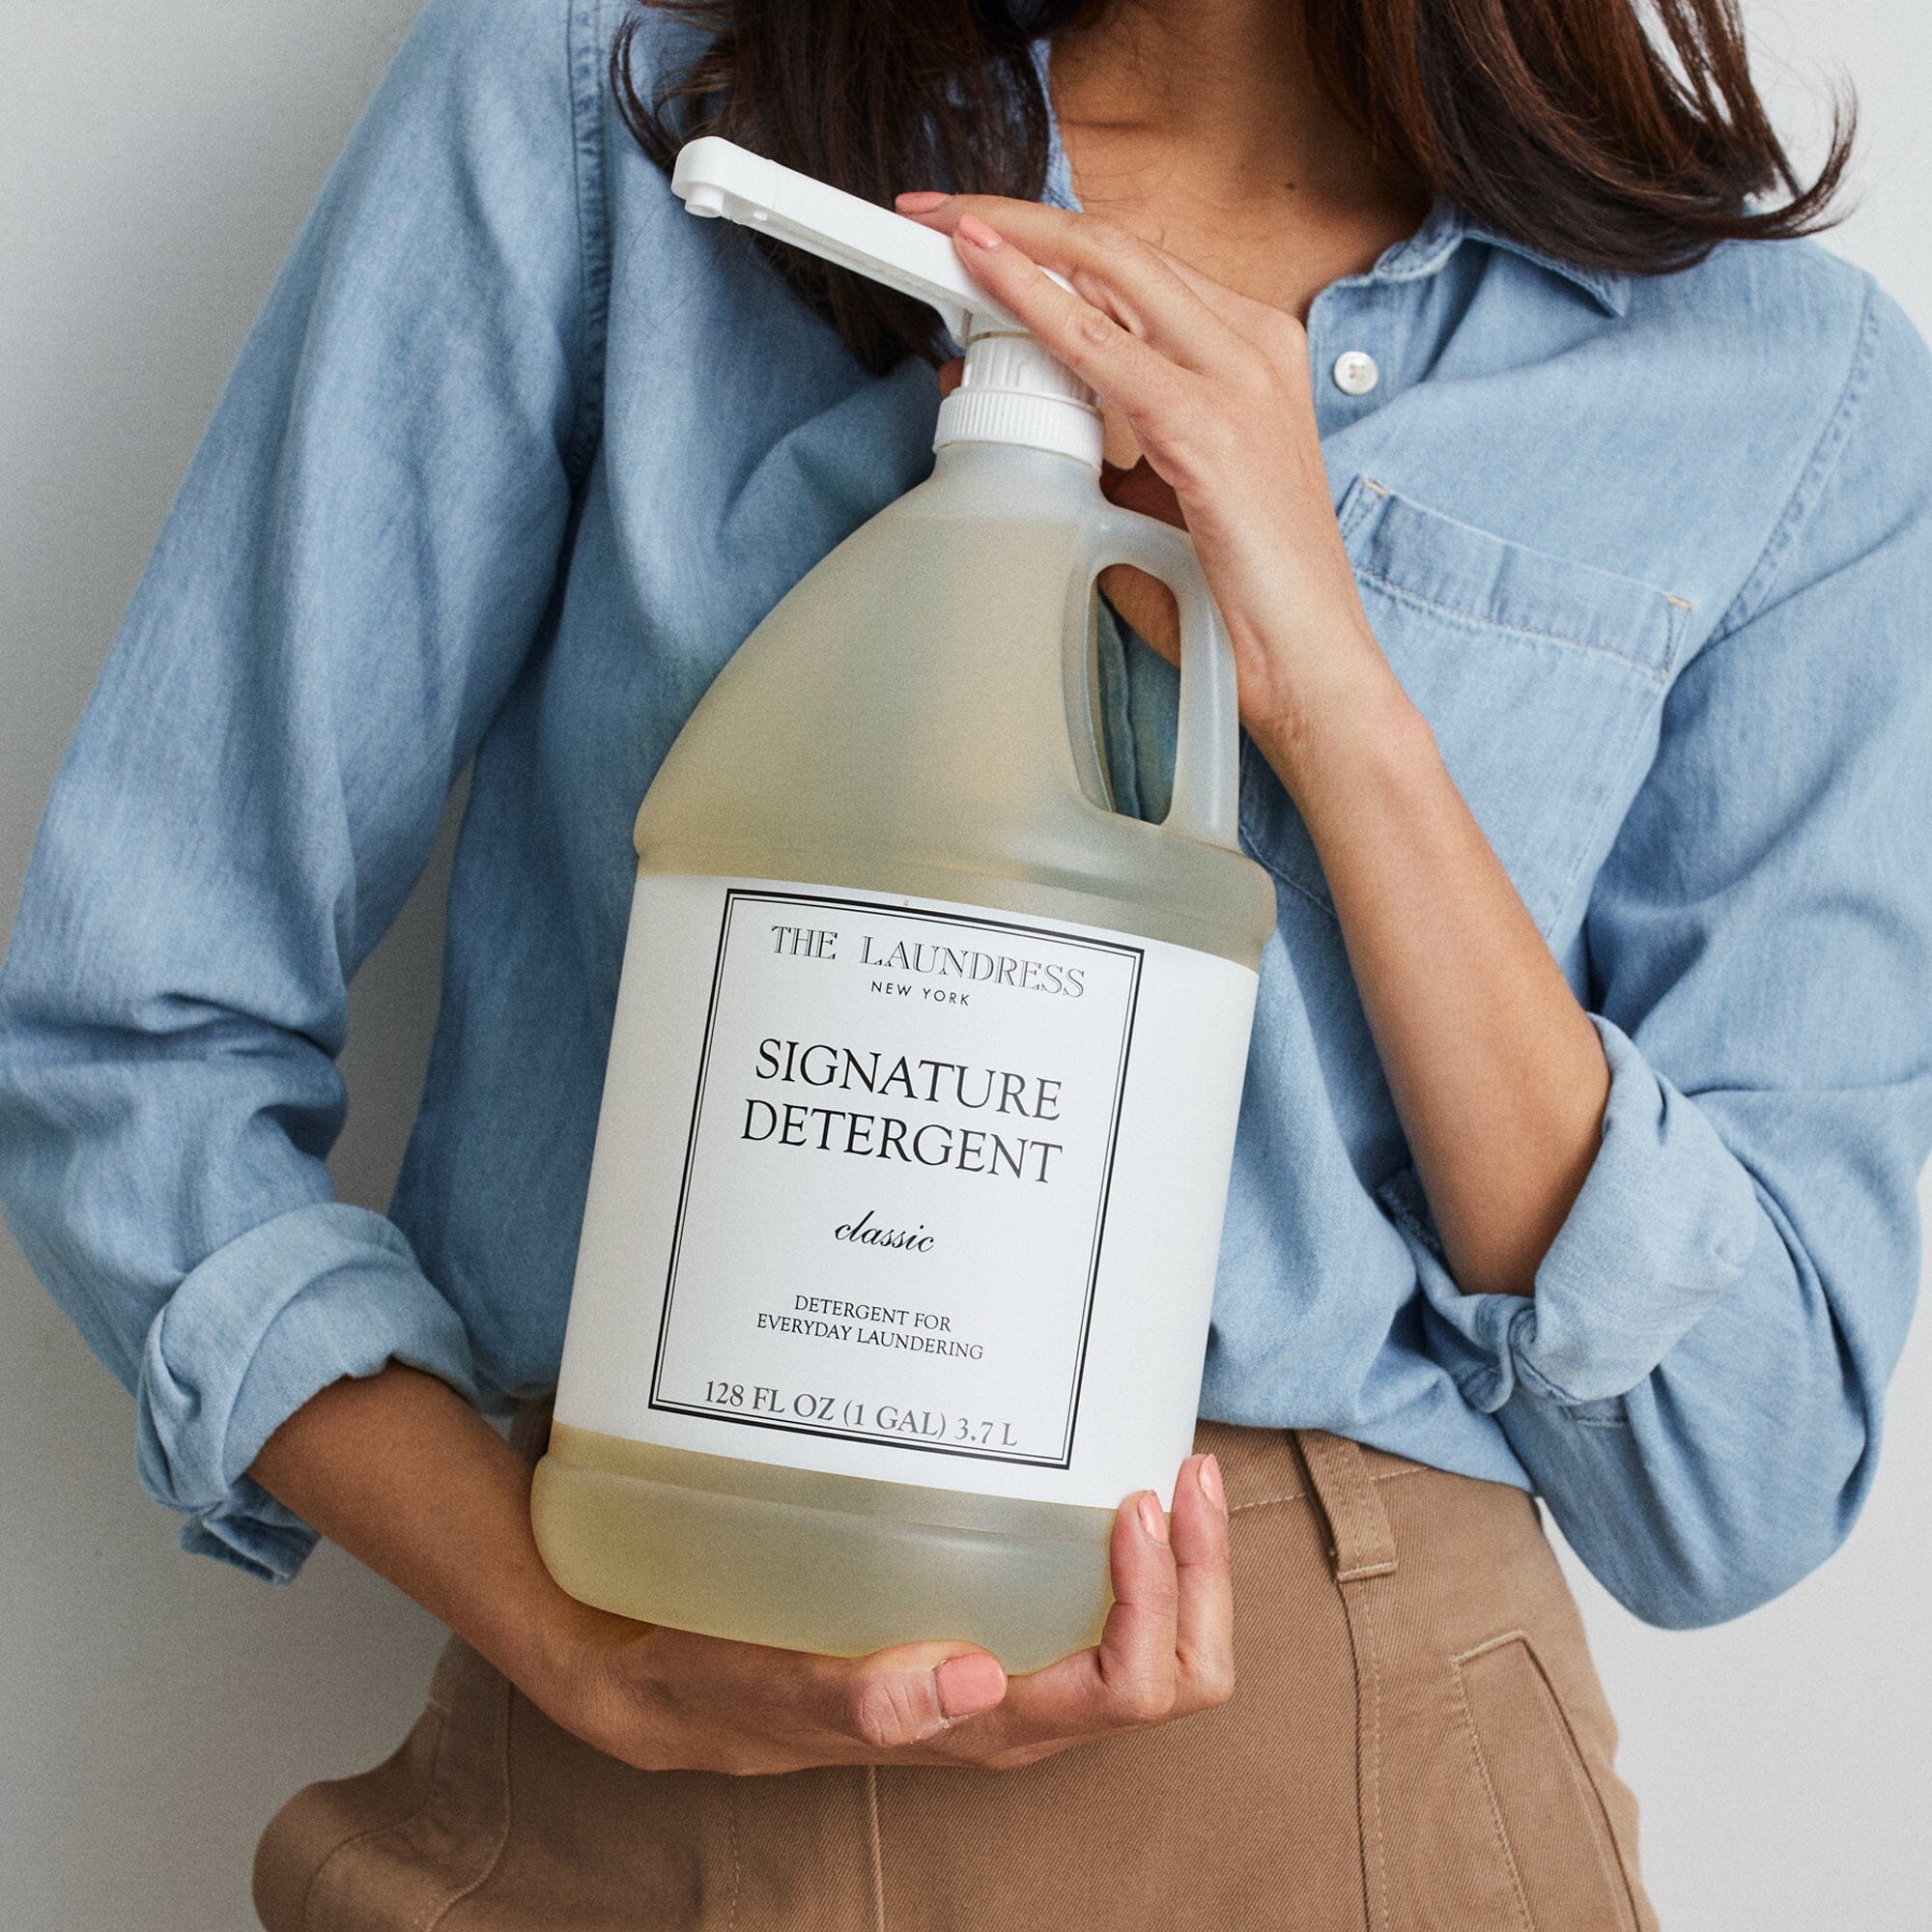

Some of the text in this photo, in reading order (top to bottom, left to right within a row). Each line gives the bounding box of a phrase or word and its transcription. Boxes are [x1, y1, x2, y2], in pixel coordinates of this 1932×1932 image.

[771, 924, 1085, 999] THE LAUNDRESS
[870, 980, 970, 1007] NEW YORK
[755, 1037, 1063, 1122] SIGNATURE
[740, 1098, 1064, 1184] DETERGENT
[834, 1209, 935, 1253] classic
[756, 1312, 983, 1360] EVERYDAY LAUNDERING
[794, 1294, 952, 1333] DETERGENT FOR
[704, 1380, 1018, 1447] 128 FL OZ (1 GAL) 3.7 L
